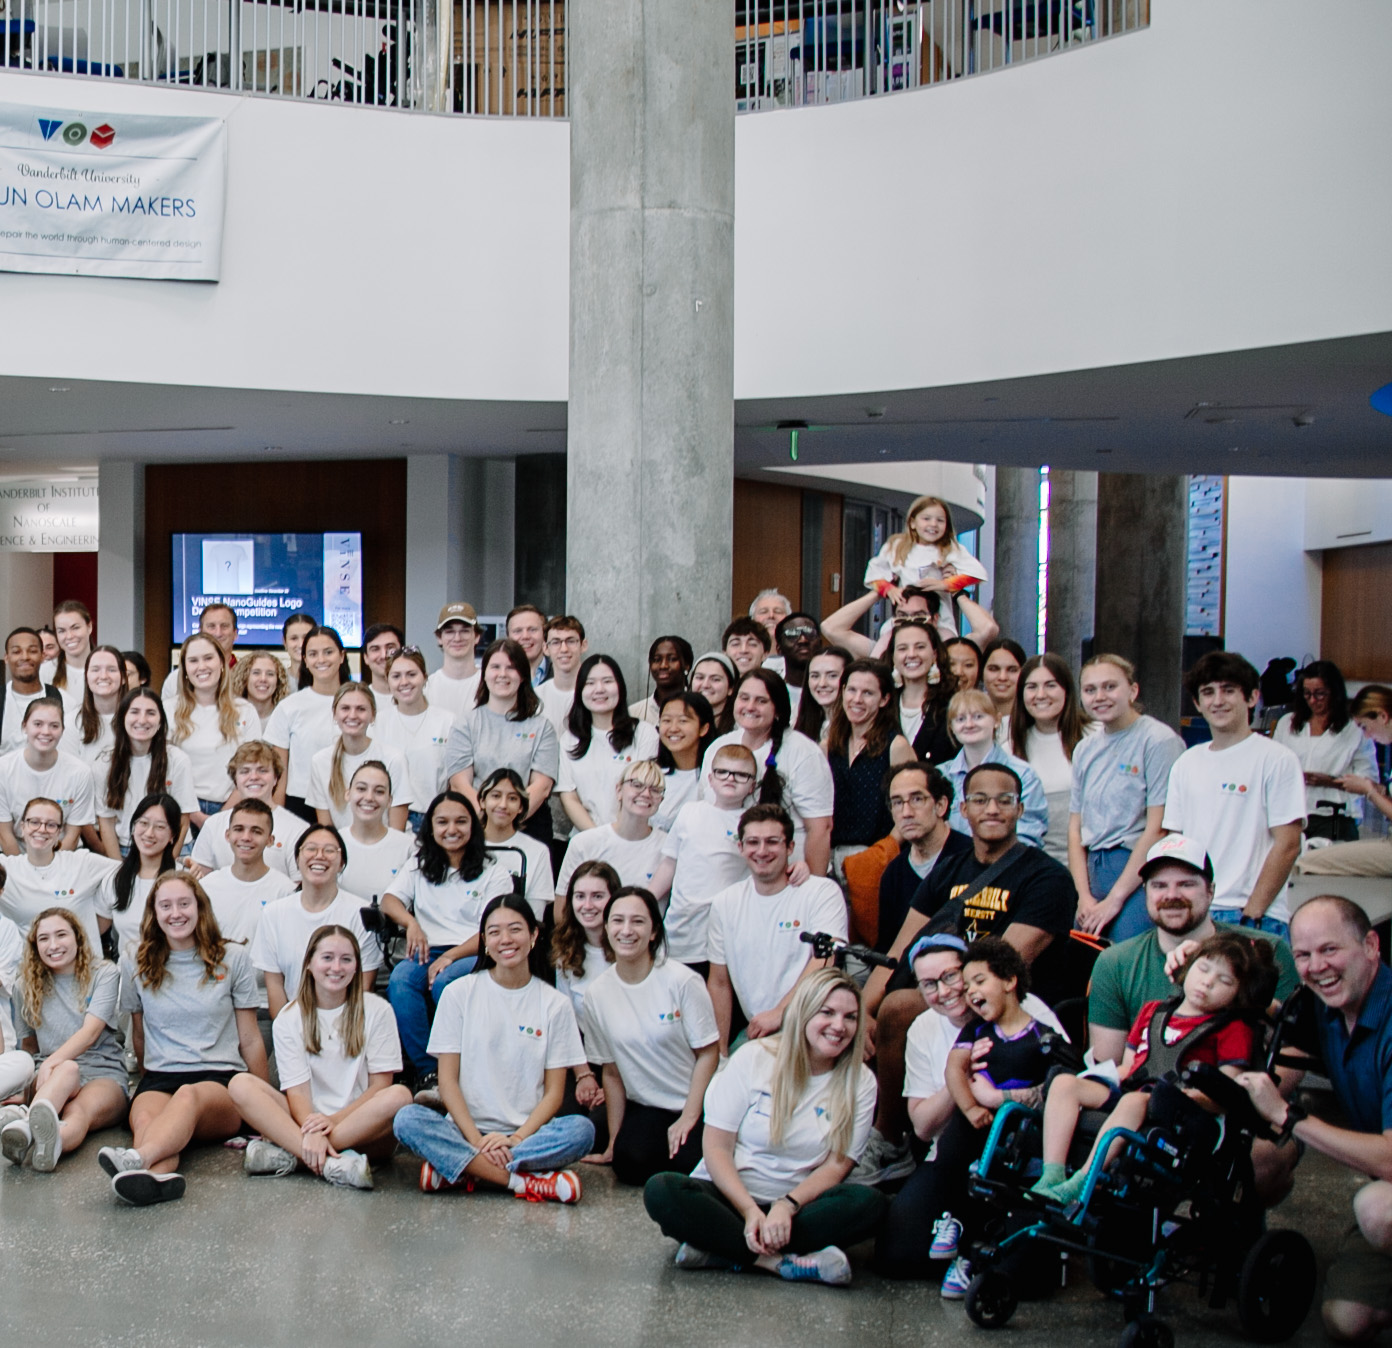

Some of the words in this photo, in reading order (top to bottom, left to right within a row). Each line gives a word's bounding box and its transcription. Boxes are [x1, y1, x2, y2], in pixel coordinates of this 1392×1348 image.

[17, 163, 79, 181] Vanderbilt
[81, 168, 141, 188] University
[35, 189, 103, 212] OLAM
[111, 194, 196, 218] MAKERS
[25, 231, 39, 240] the
[41, 232, 65, 242] world
[67, 233, 99, 245] through
[173, 239, 202, 249] design
[37, 503, 51, 513] OF
[13, 515, 77, 529] NANOSCALE
[28, 535, 37, 546] &
[41, 533, 99, 547] ENGINEERIN
[222, 596, 278, 608] NanoGuides
[279, 597, 303, 609] Logo
[236, 607, 277, 618] ompetition
